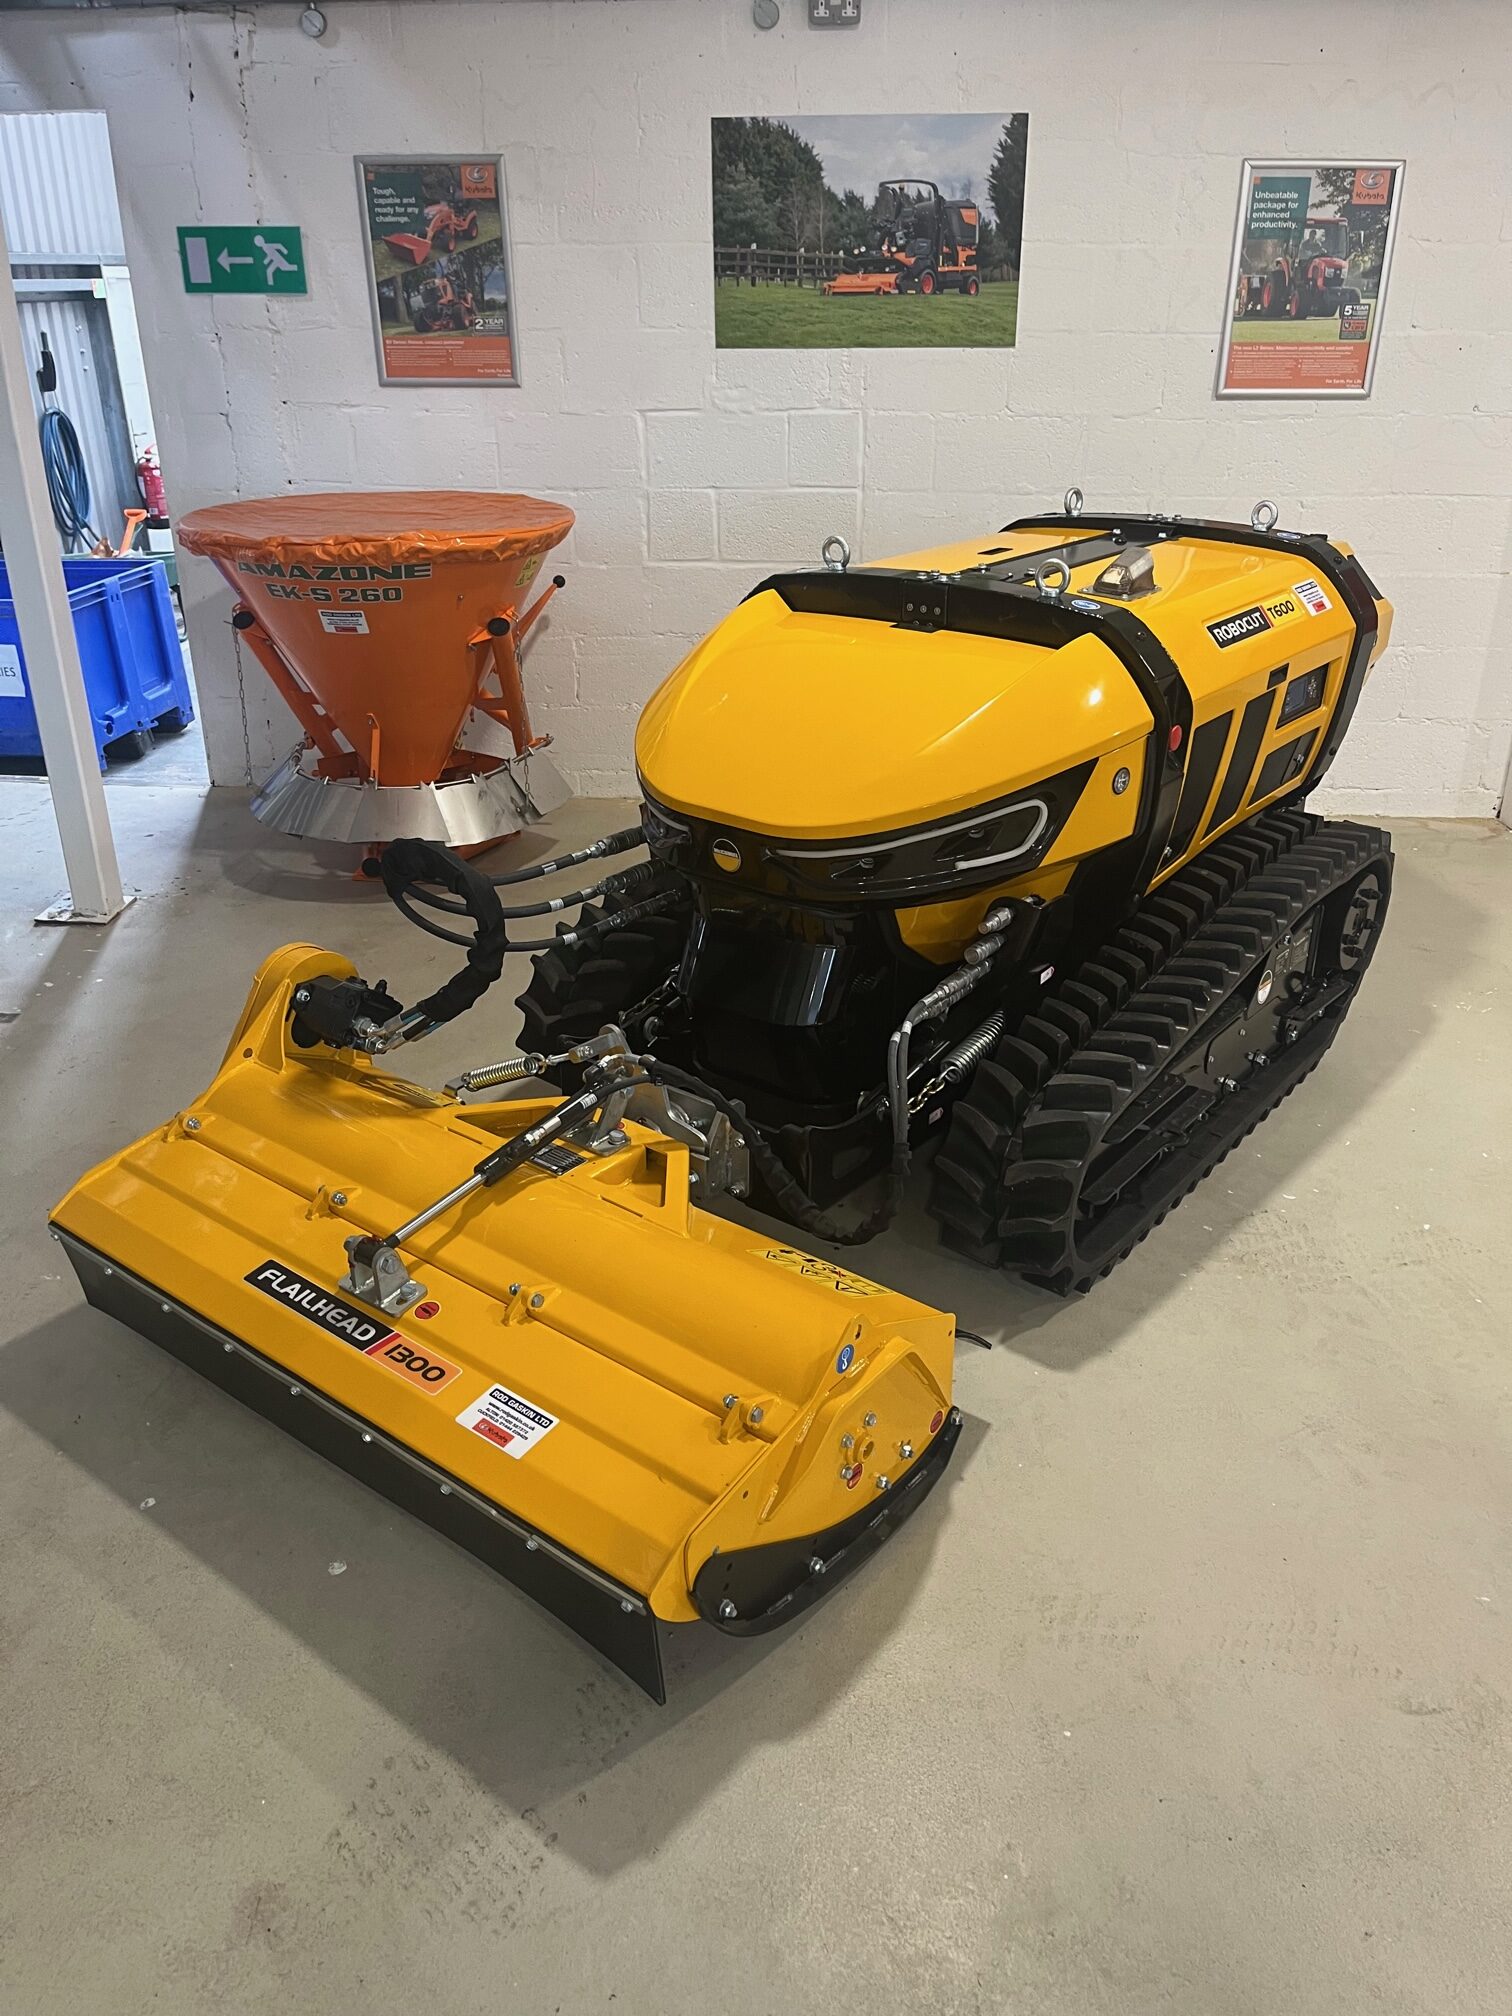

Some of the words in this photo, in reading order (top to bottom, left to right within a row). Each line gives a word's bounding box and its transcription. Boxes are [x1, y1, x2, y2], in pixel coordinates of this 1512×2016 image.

[1255, 191, 1299, 199] Unbeatable
[1356, 192, 1385, 200] Kubota
[374, 197, 401, 205] capable
[1254, 201, 1286, 210] package
[1287, 201, 1299, 209] for
[375, 206, 394, 214] ready
[1251, 221, 1298, 229] productivity.
[1343, 305, 1353, 316] 5
[475, 319, 484, 330] 2
[238, 563, 431, 581] AMAZONE
[265, 583, 333, 602] EK-S
[338, 587, 403, 603] 260
[1212, 612, 1265, 643] ROBOCUT
[1267, 600, 1295, 619] T600
[0, 666, 16, 677] IES
[257, 1269, 377, 1341] FLAILHEAD
[383, 1343, 446, 1382] 1300
[491, 1390, 509, 1402] ROD
[508, 1399, 535, 1418] GASKIN
[535, 1415, 550, 1427] LTD
[487, 1427, 508, 1443] Kubota
